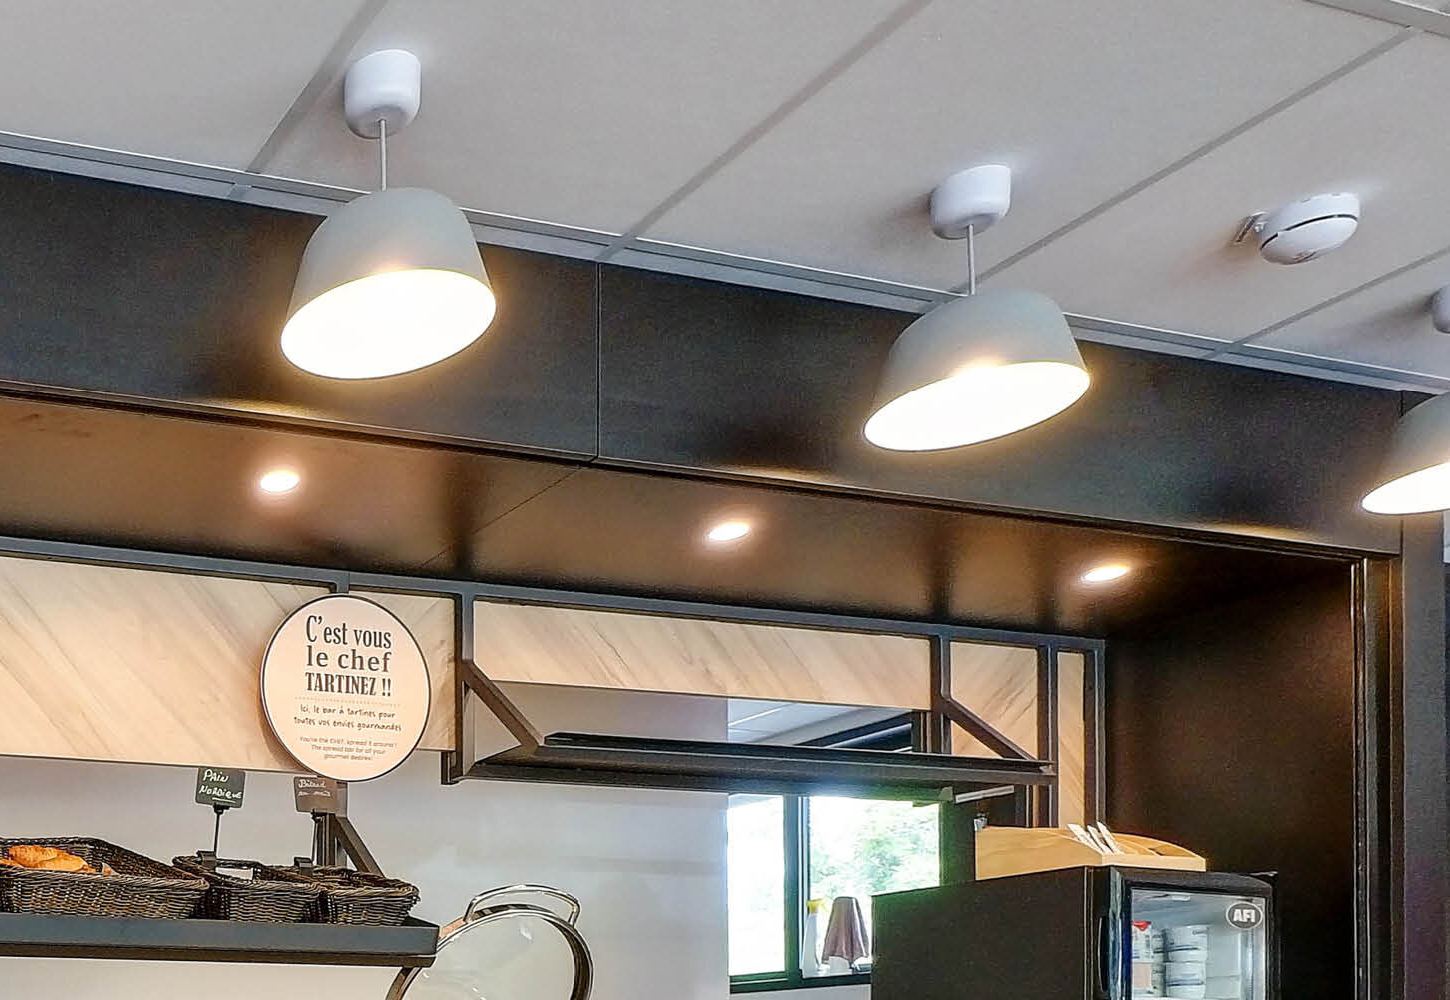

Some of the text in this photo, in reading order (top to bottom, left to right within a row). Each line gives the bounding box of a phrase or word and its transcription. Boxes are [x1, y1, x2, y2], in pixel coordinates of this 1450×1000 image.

[306, 615, 391, 649] C'est vous
[306, 645, 392, 673] le chef
[305, 672, 391, 697] TARTINEZ !!
[293, 716, 315, 726] toutes
[332, 719, 355, 729] envies
[357, 720, 402, 732] gourmandes
[313, 704, 320, 714] le
[322, 705, 336, 714] bar
[338, 705, 345, 714] à
[347, 707, 376, 718] tartines
[378, 710, 396, 720] pour
